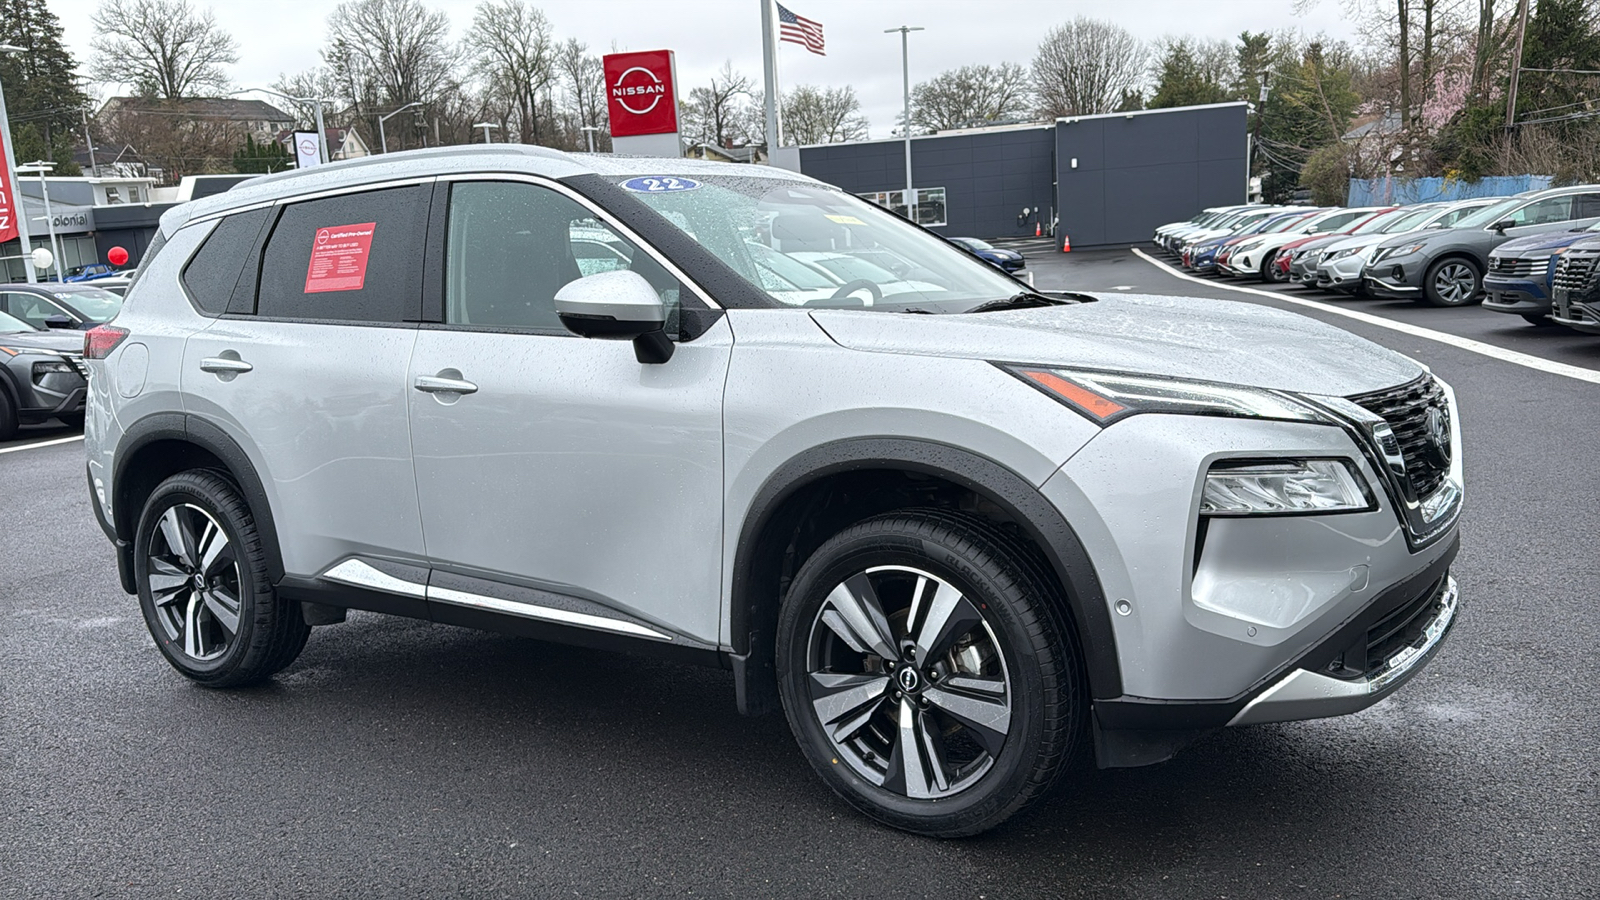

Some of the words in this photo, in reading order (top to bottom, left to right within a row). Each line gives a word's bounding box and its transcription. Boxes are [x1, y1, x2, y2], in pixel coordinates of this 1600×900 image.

[612, 84, 665, 97] NISSAN
[642, 177, 684, 191] 22
[945, 554, 1016, 625] BLACKHAWK
